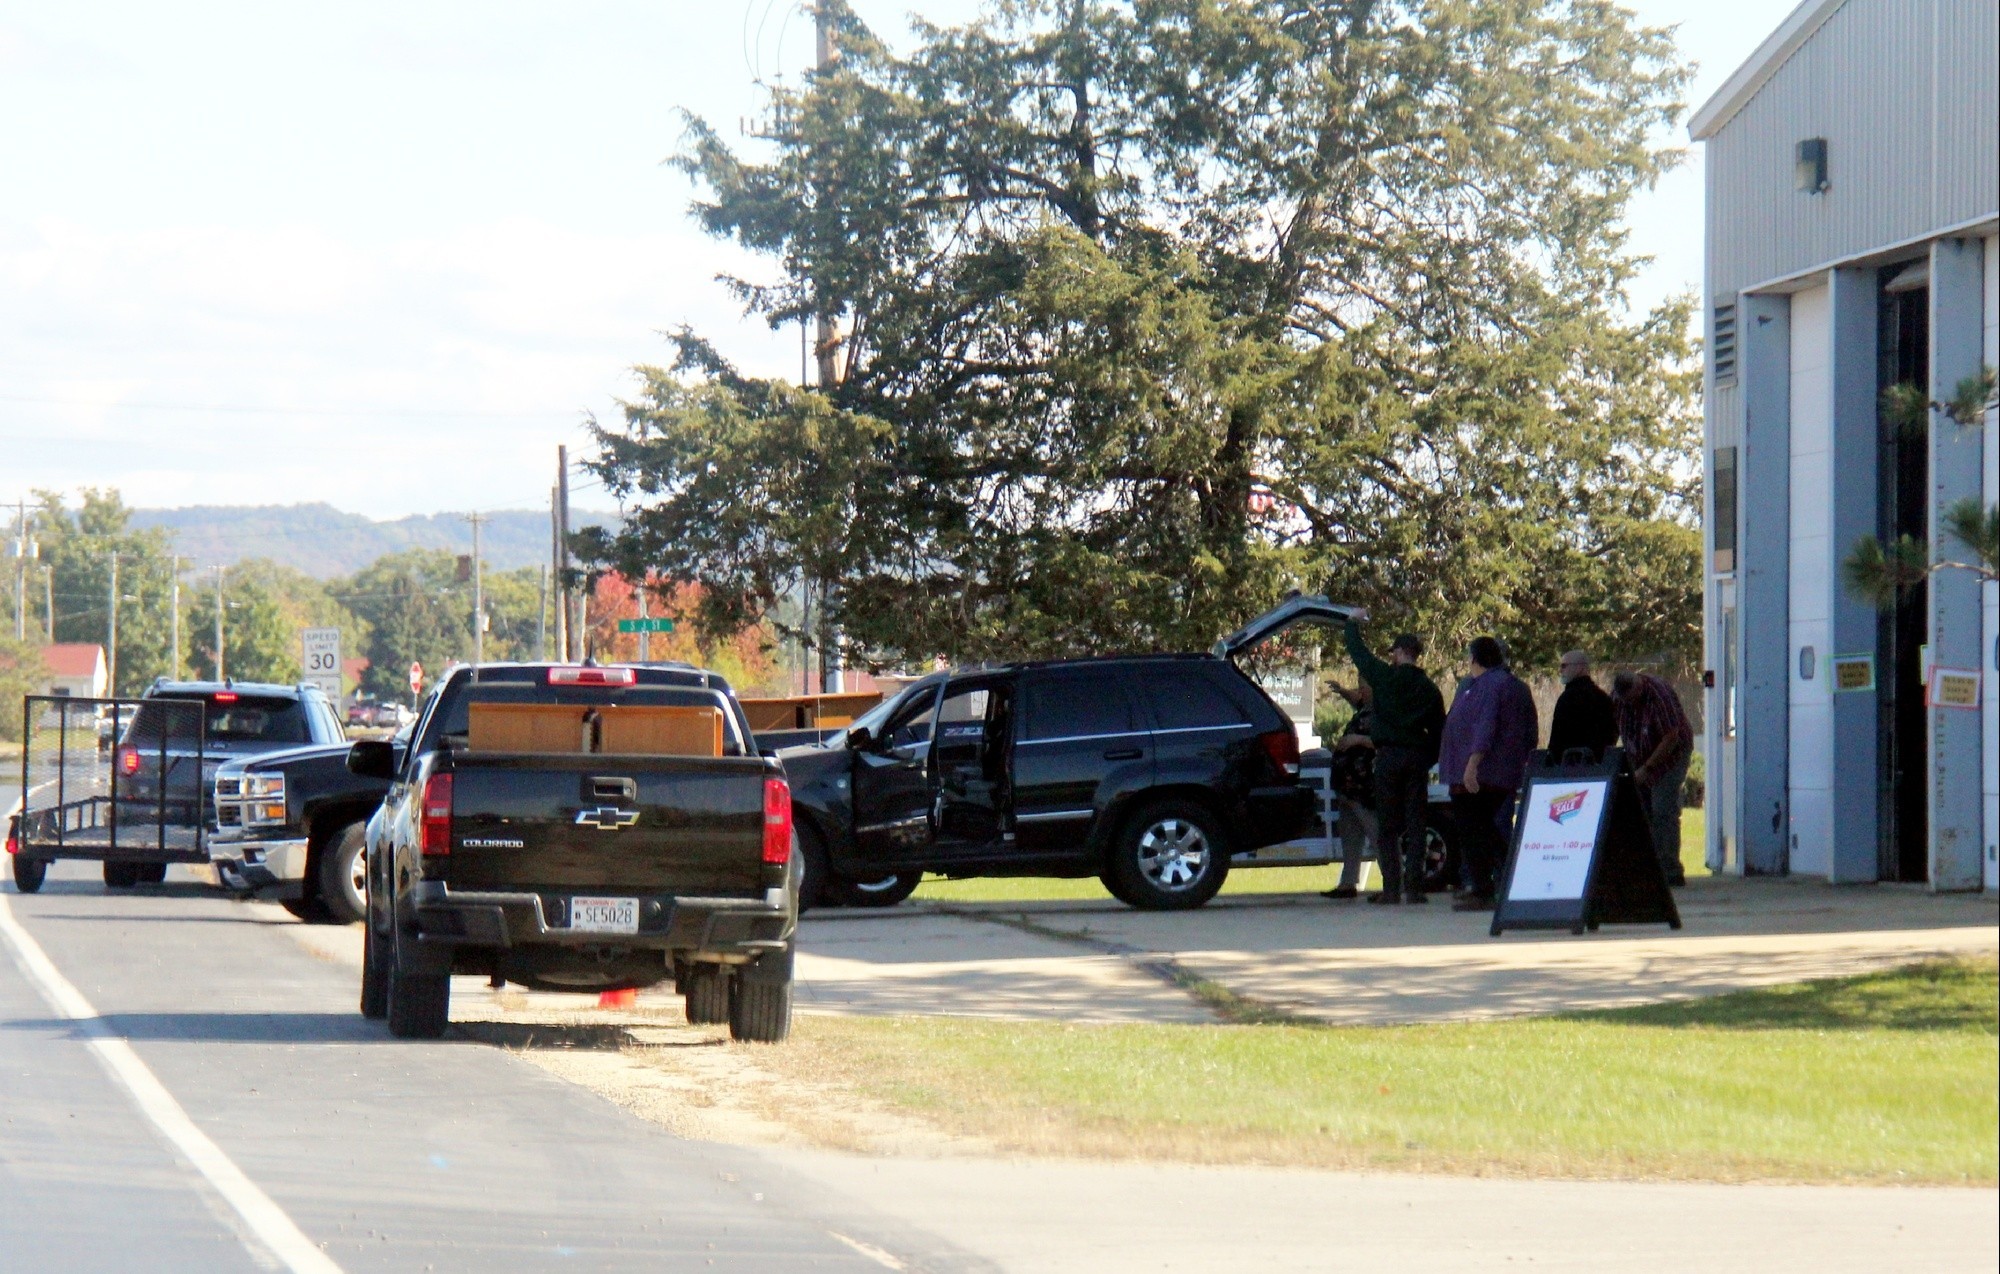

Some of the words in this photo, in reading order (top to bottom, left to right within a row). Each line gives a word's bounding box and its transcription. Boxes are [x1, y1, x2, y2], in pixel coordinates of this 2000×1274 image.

[630, 620, 635, 631] S
[306, 633, 338, 641] SPEED
[309, 643, 333, 651] LIMIT
[310, 653, 335, 670] 30
[1555, 802, 1576, 816] SALE
[463, 839, 524, 848] COLORADO
[1563, 841, 1579, 850] 1:00
[1580, 842, 1593, 851] pm
[586, 907, 632, 924] SE5028
